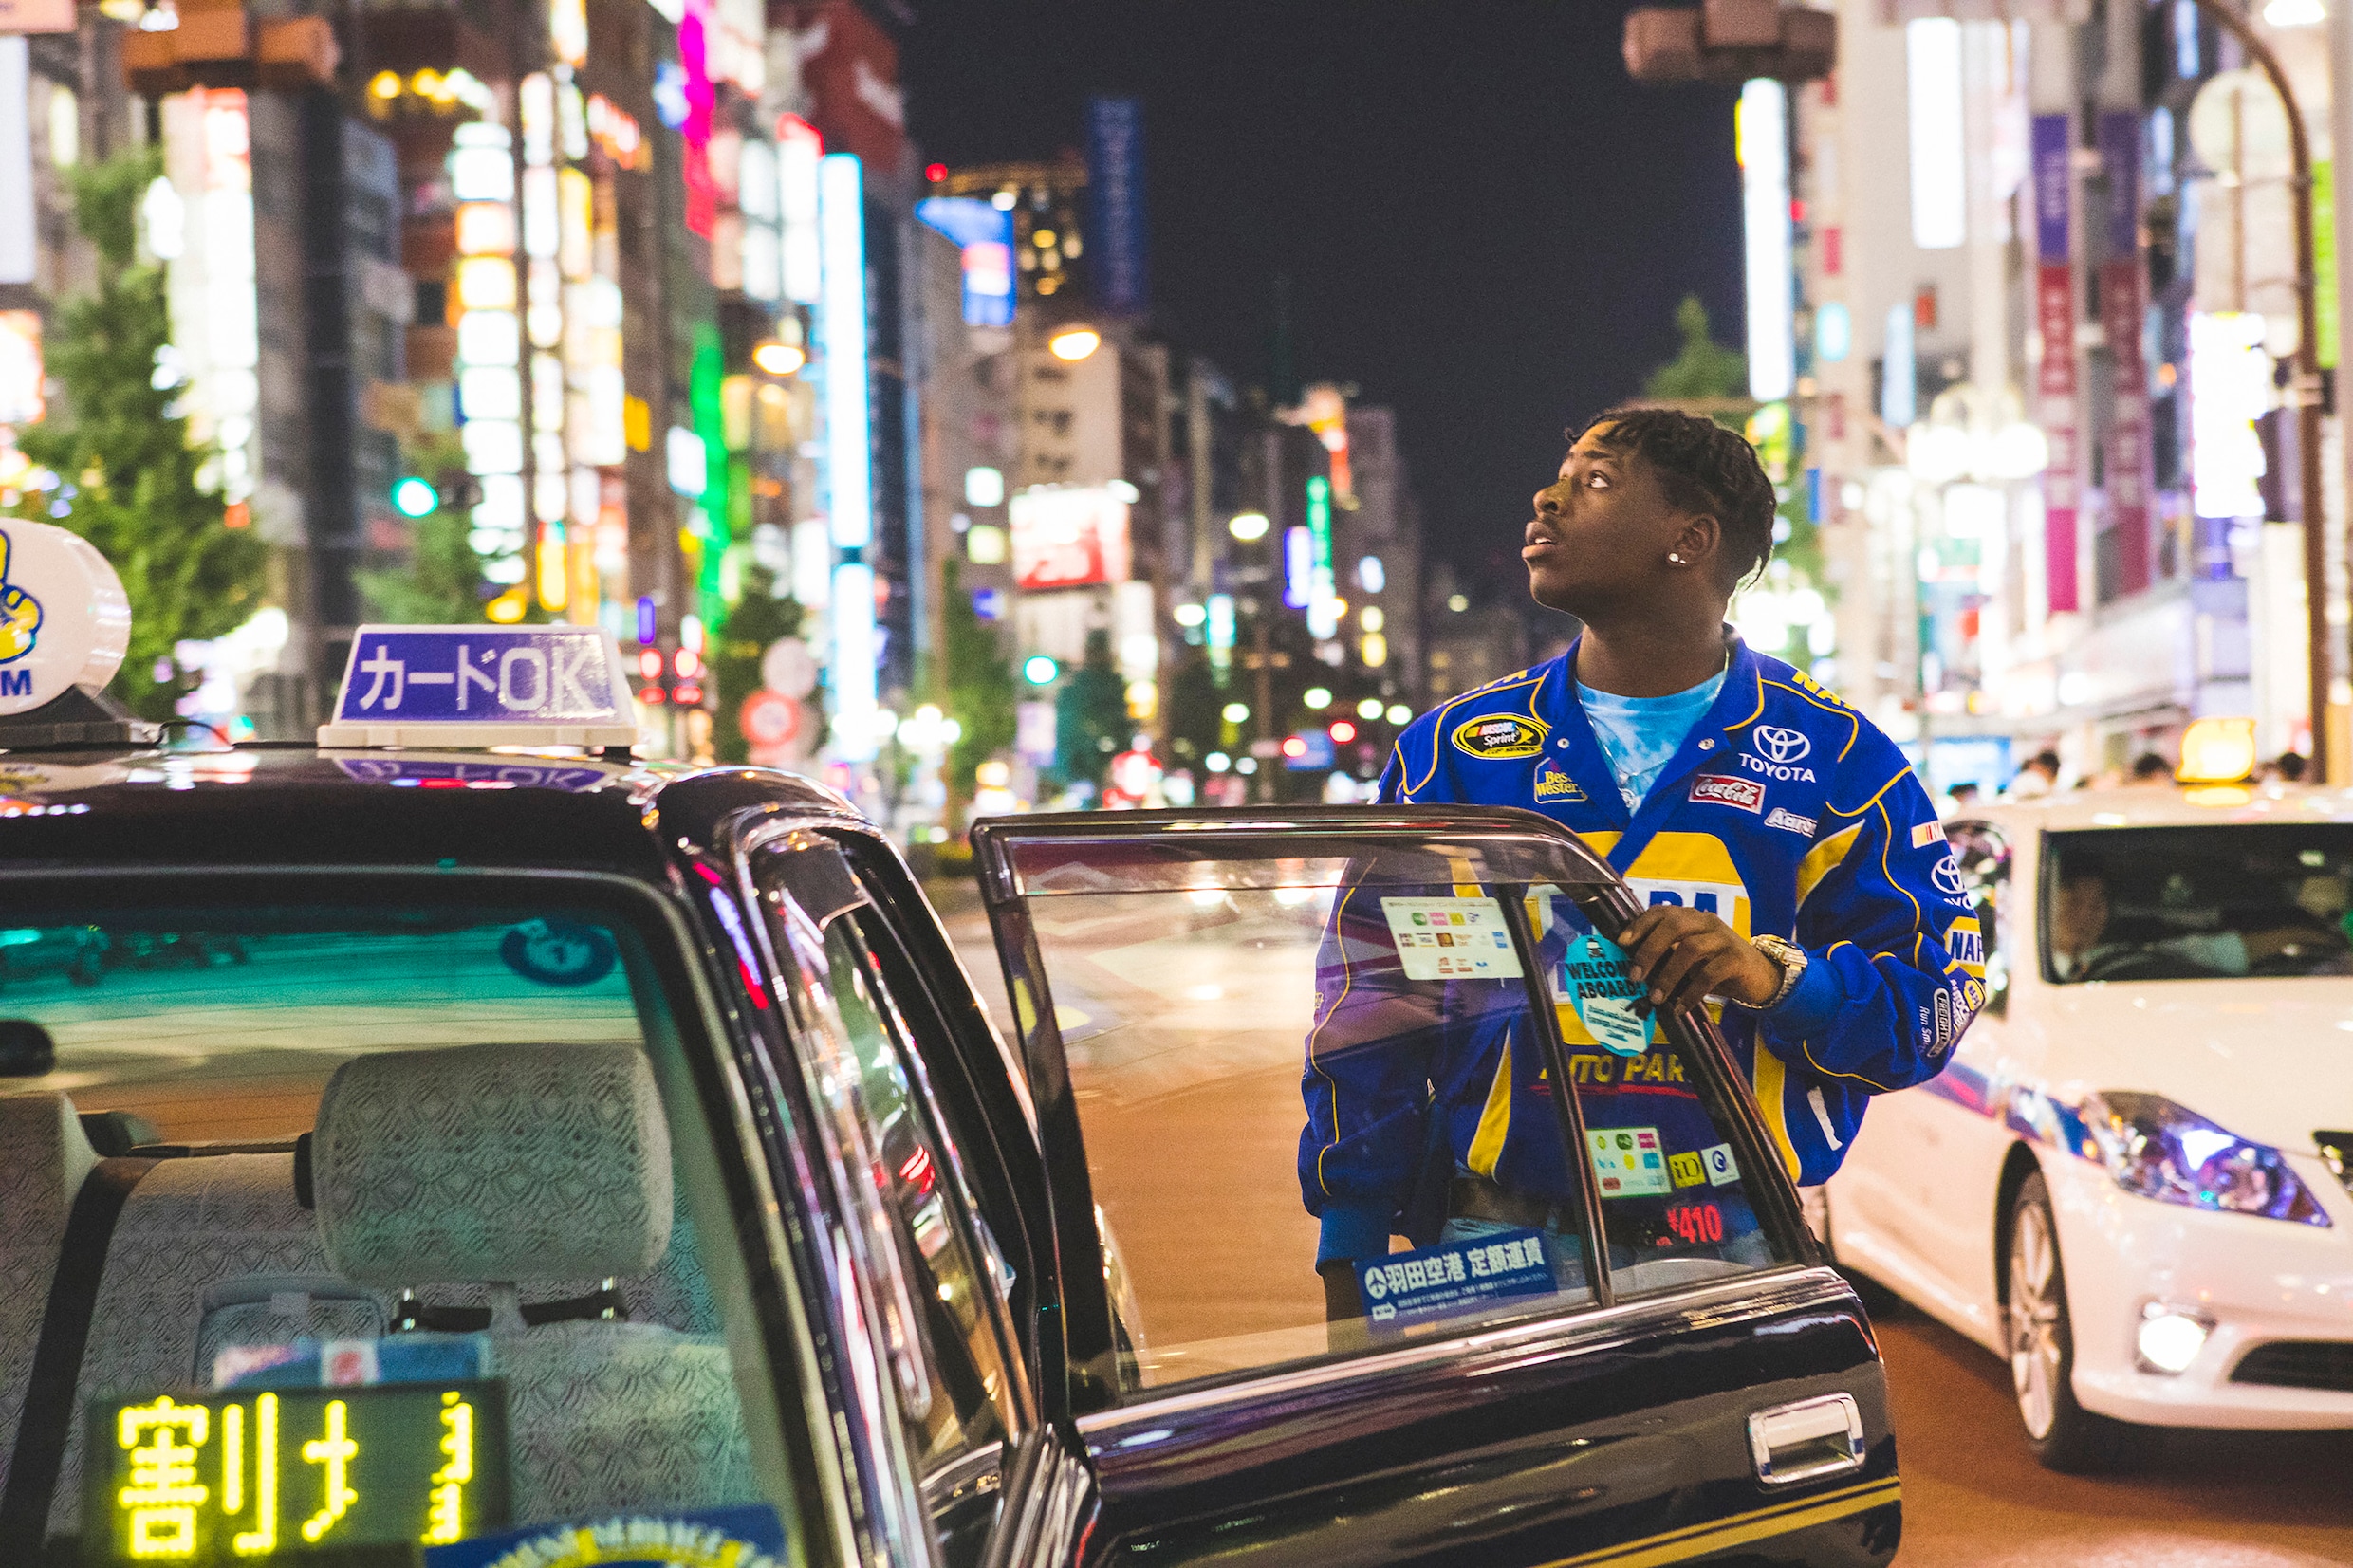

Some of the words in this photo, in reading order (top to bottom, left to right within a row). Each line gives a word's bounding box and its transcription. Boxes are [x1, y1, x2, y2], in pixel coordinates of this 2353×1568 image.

[359, 644, 605, 712] カードOK
[1791, 670, 1858, 710] NA
[1483, 733, 1517, 747] Sprint
[1545, 770, 1572, 784] Bes
[1738, 752, 1816, 784] TOYOTA
[1536, 781, 1584, 797] Wester
[1565, 960, 1631, 980] WELCOM
[1918, 1005, 1930, 1025] Run
[1623, 1053, 1685, 1082] PAR
[1673, 1157, 1700, 1180] iD
[1667, 1203, 1723, 1244] ¥410
[1384, 1251, 1467, 1295] 羽田空港
[1466, 1236, 1546, 1279] 定額運賃
